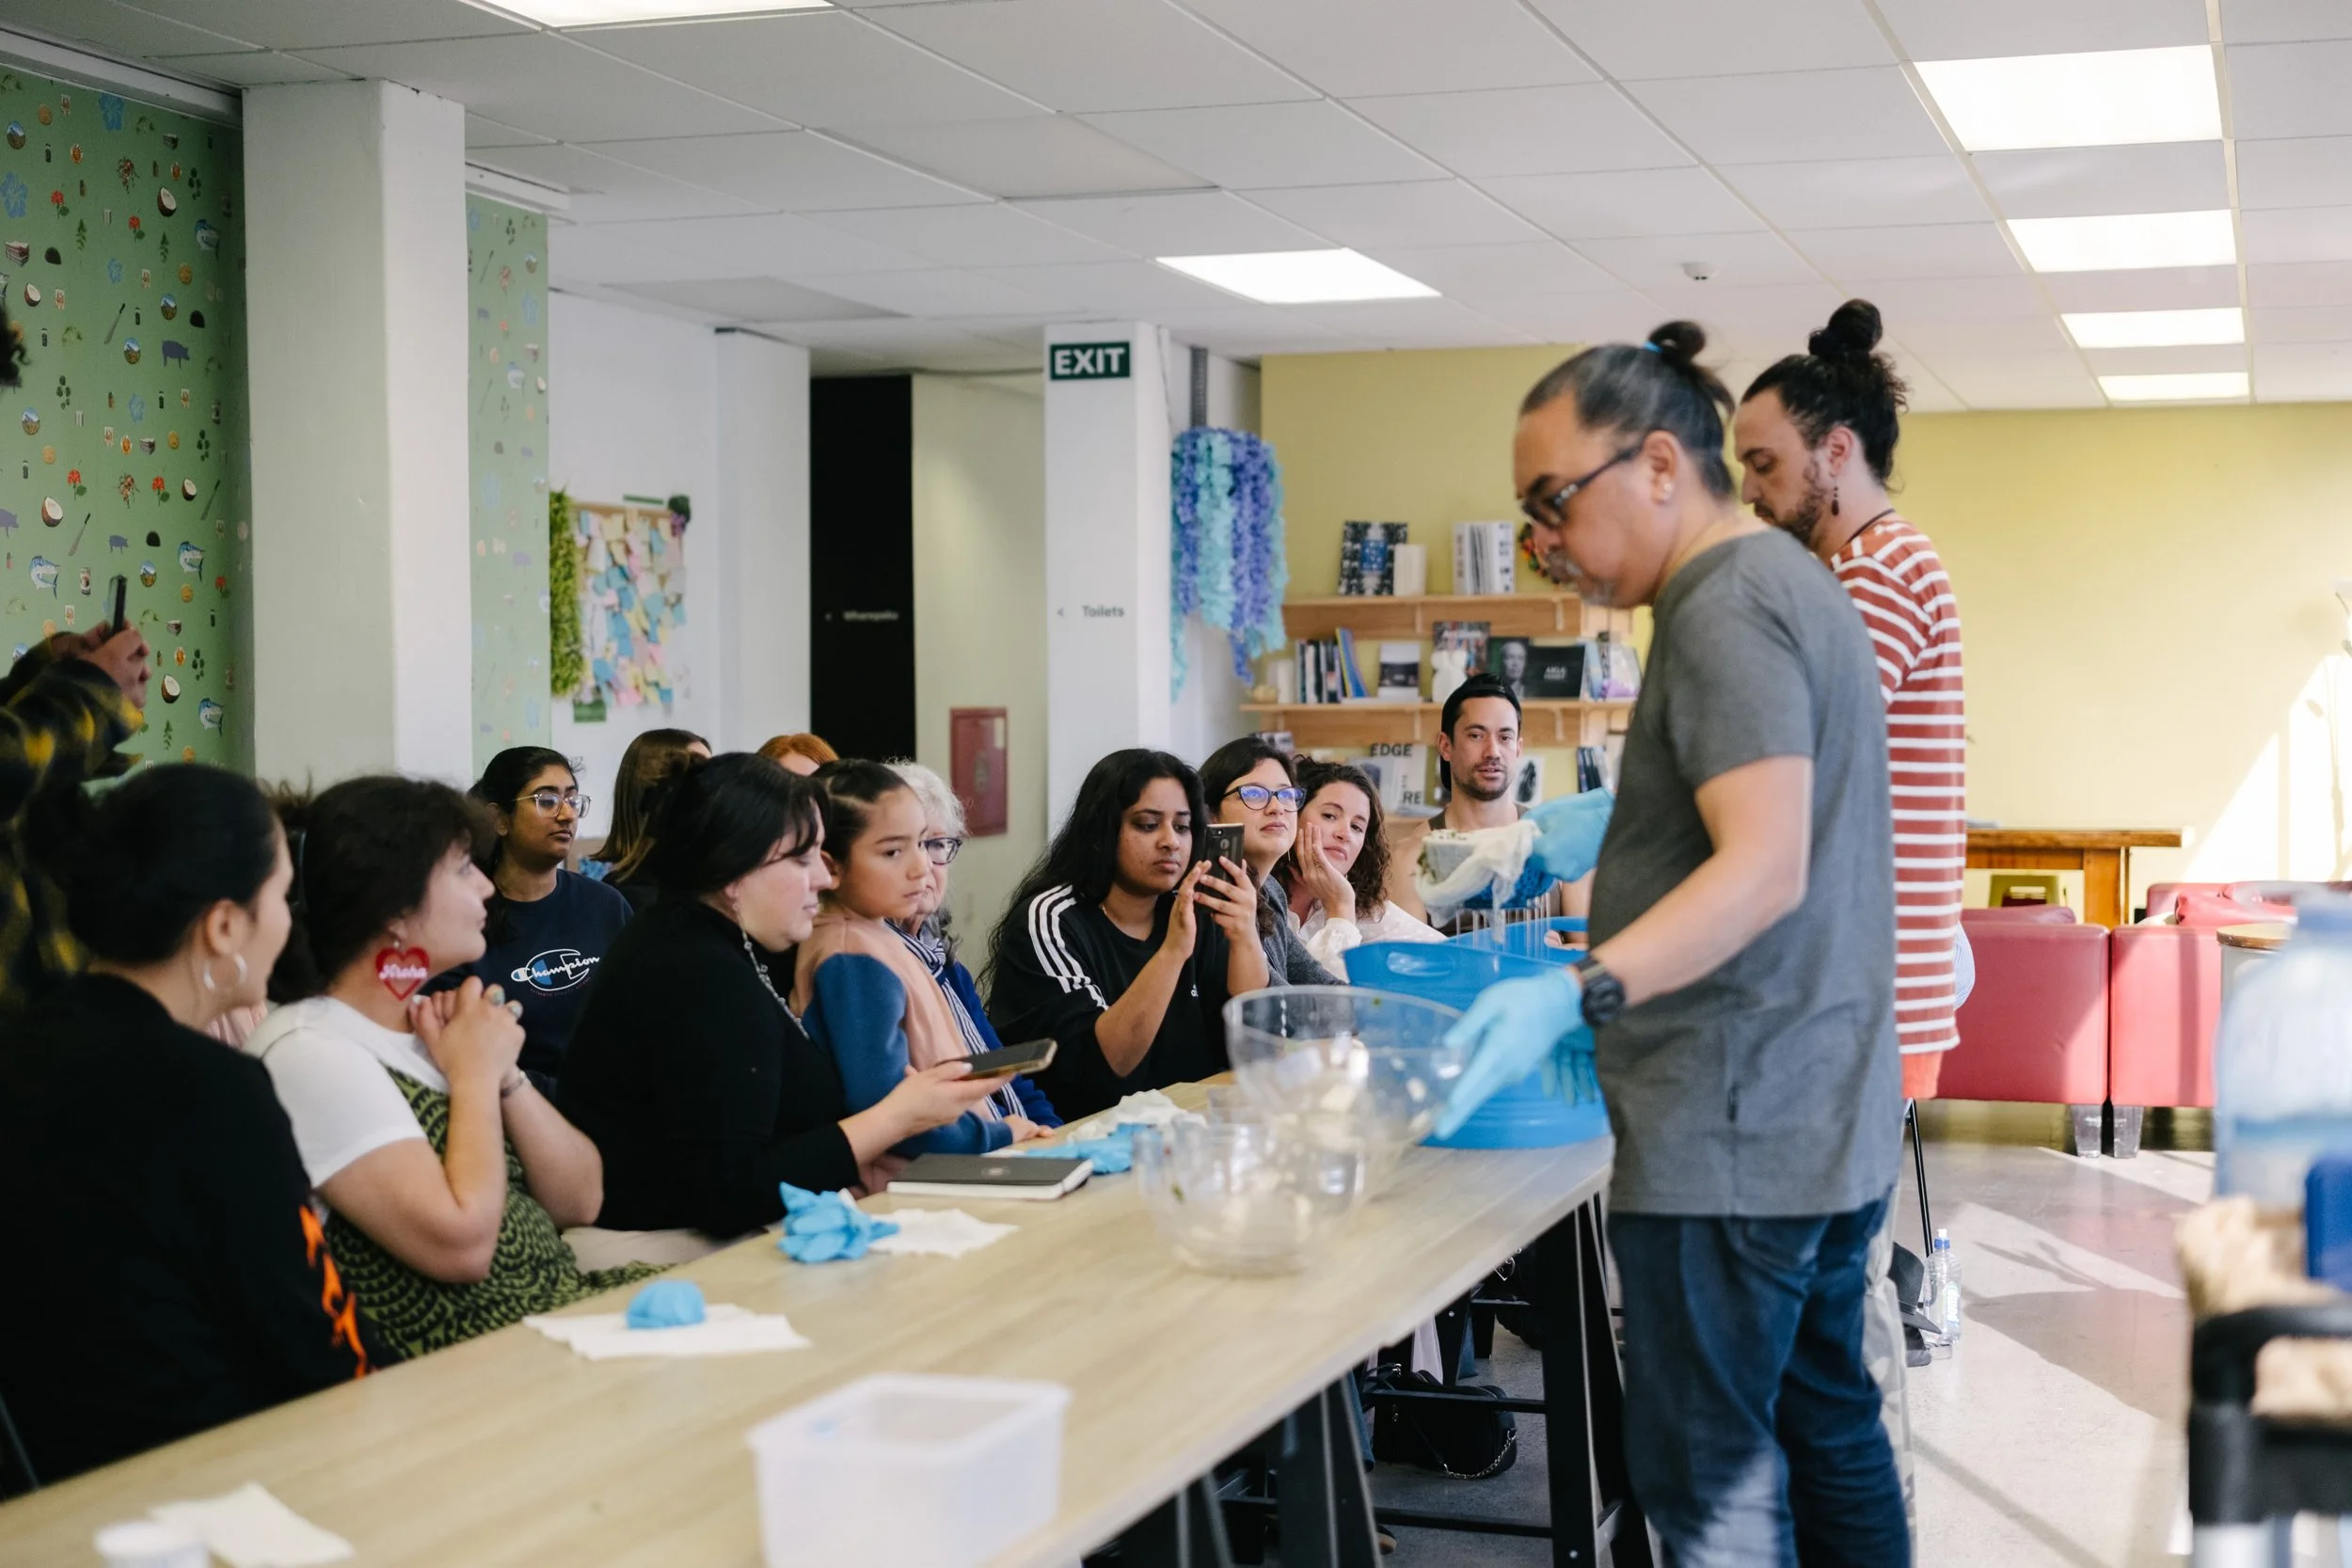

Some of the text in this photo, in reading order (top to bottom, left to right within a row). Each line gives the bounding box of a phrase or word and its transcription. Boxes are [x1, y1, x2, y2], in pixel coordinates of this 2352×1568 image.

[1054, 347, 1125, 375] EXIT
[1081, 604, 1125, 618] Toilets
[1370, 743, 1413, 757] EDGE
[511, 954, 600, 982] Champion
